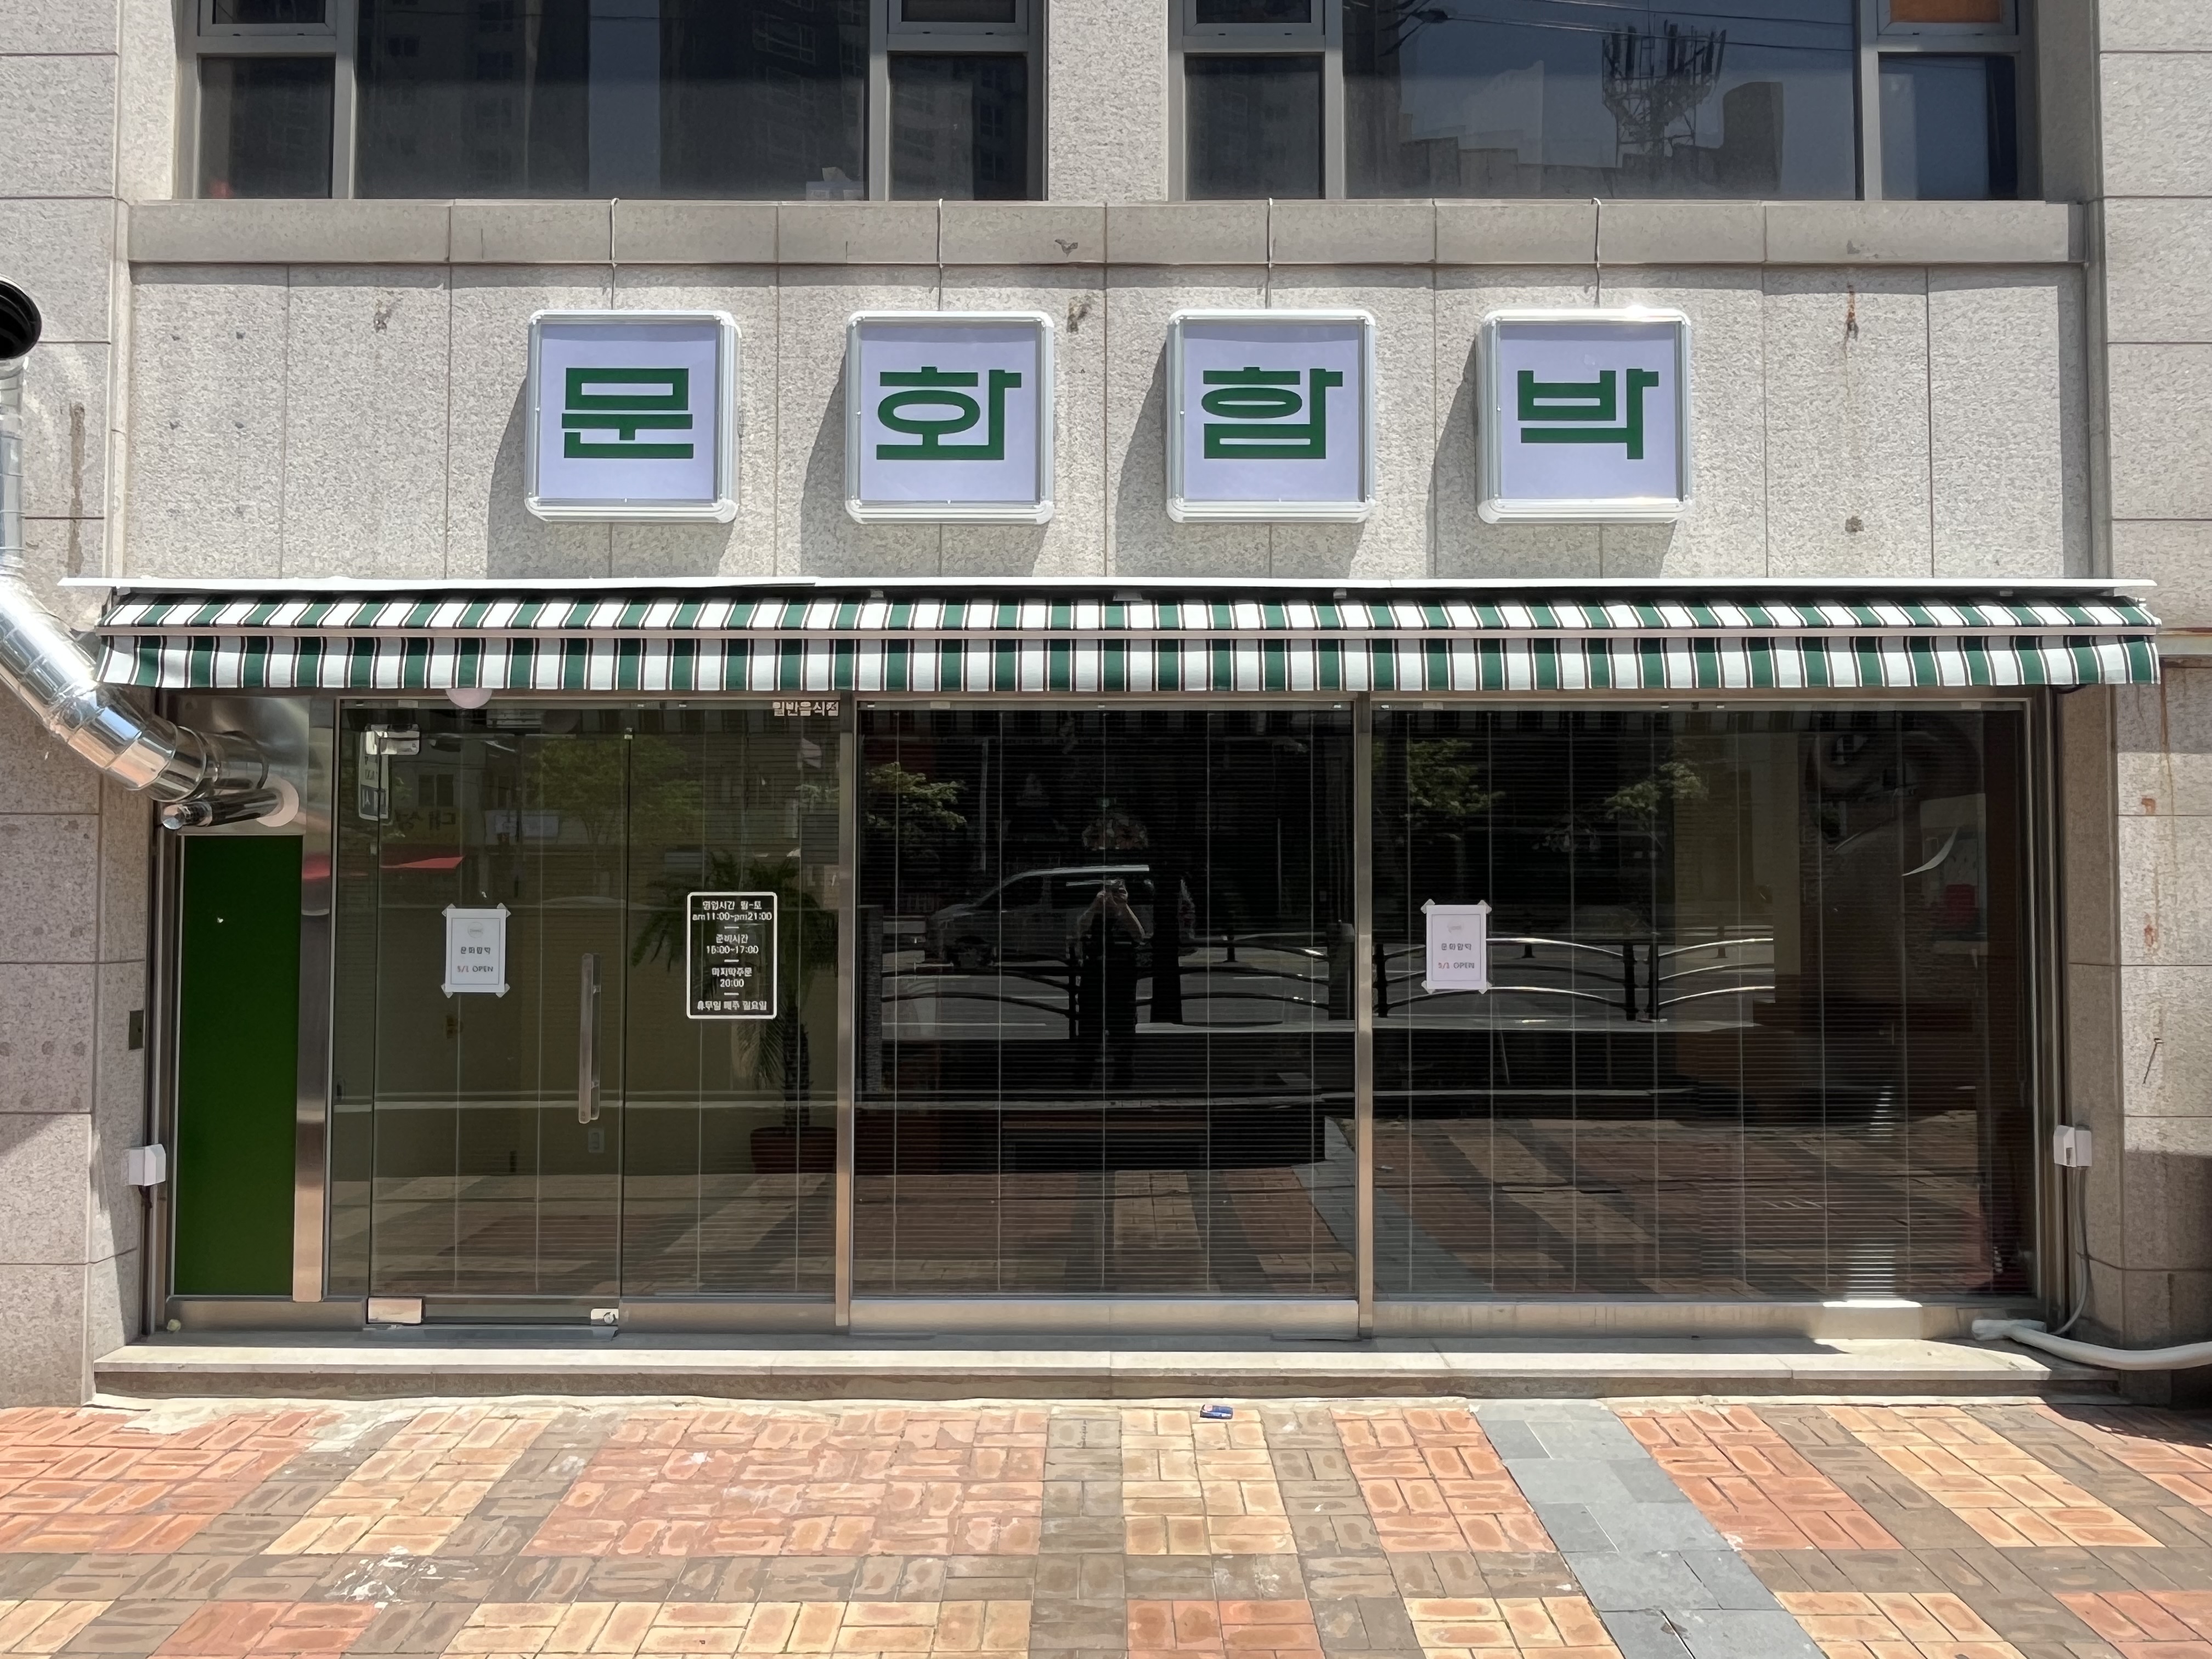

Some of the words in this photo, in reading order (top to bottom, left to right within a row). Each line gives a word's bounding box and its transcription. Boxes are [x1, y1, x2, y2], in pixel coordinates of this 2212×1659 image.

[772, 701, 839, 716] 일반음식점
[702, 900, 735, 910] 영업시간
[716, 934, 748, 944] 준비시간
[720, 978, 744, 988] 20:00
